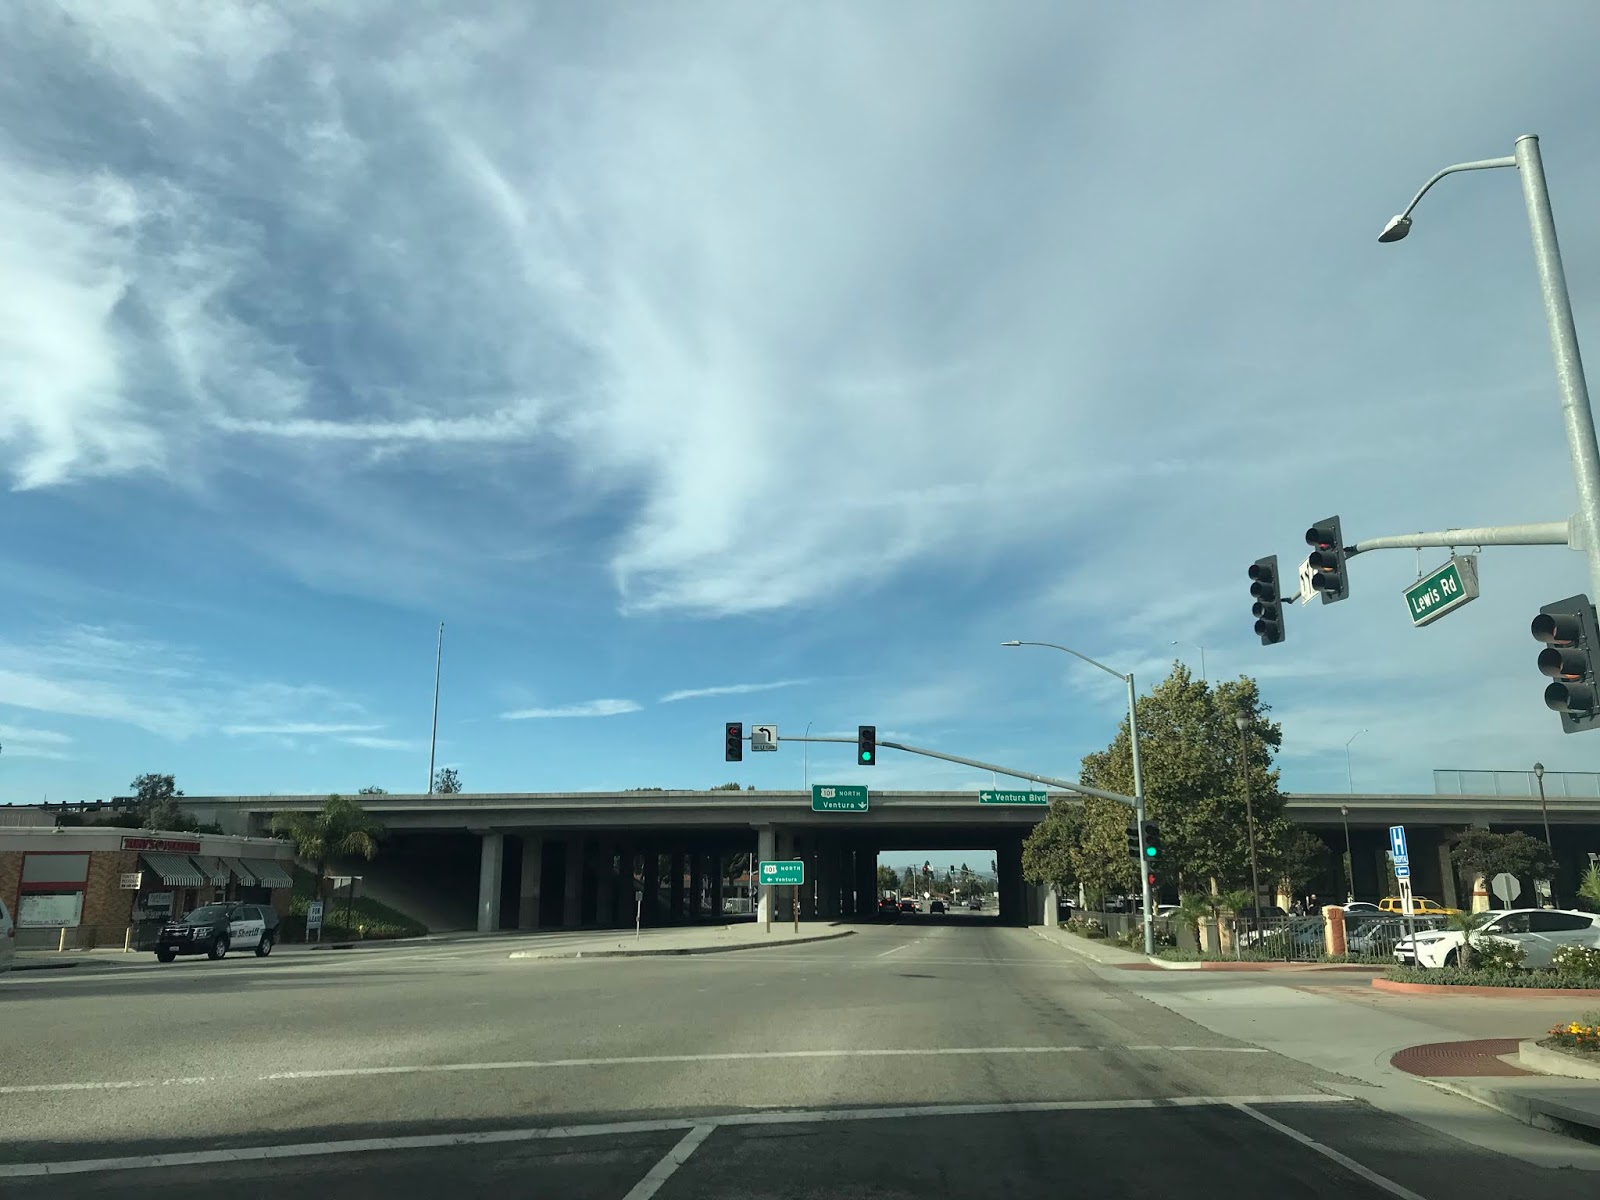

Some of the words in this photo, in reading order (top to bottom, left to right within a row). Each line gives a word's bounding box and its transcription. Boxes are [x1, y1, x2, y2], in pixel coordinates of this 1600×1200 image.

[1412, 587, 1440, 614] Lewis
[1440, 574, 1457, 597] Rd
[995, 793, 1026, 802] Ventura
[1029, 793, 1046, 802] Blvd
[1393, 828, 1405, 856] H
[238, 927, 260, 938] Sheriff
